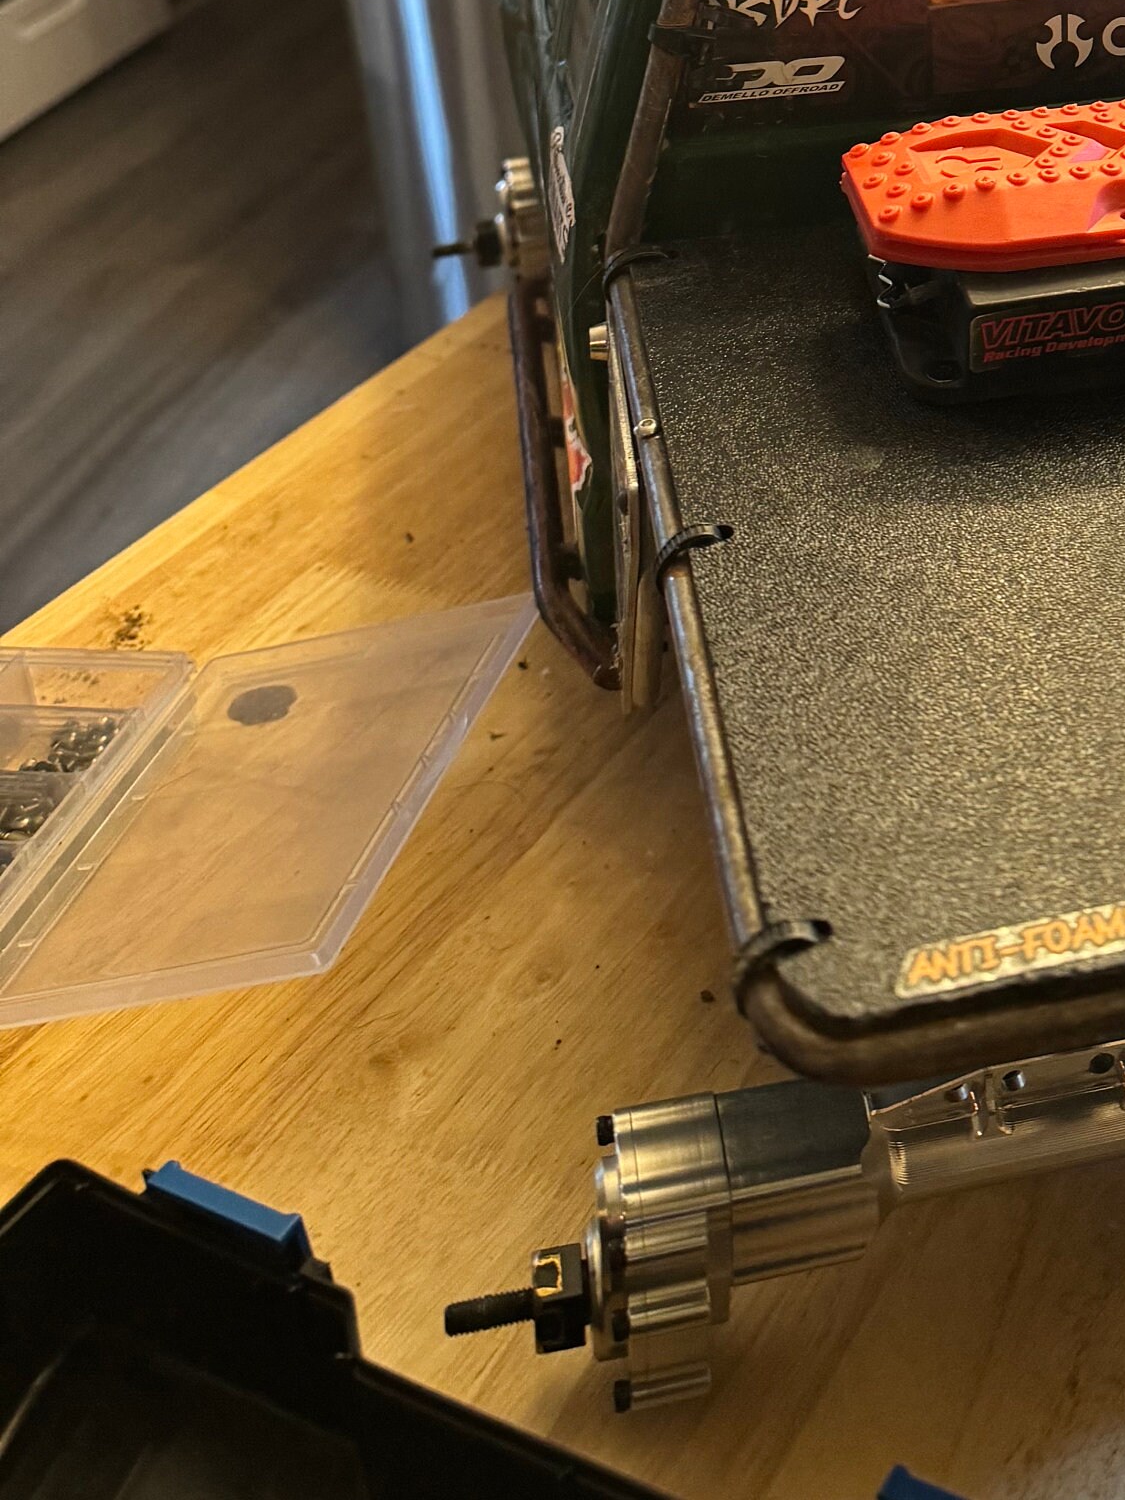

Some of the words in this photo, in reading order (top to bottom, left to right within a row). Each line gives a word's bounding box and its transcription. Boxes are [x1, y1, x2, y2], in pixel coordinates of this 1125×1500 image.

[702, 90, 769, 102] DEMELLO
[772, 82, 840, 96] OFFROAD
[983, 345, 1042, 364] Racing
